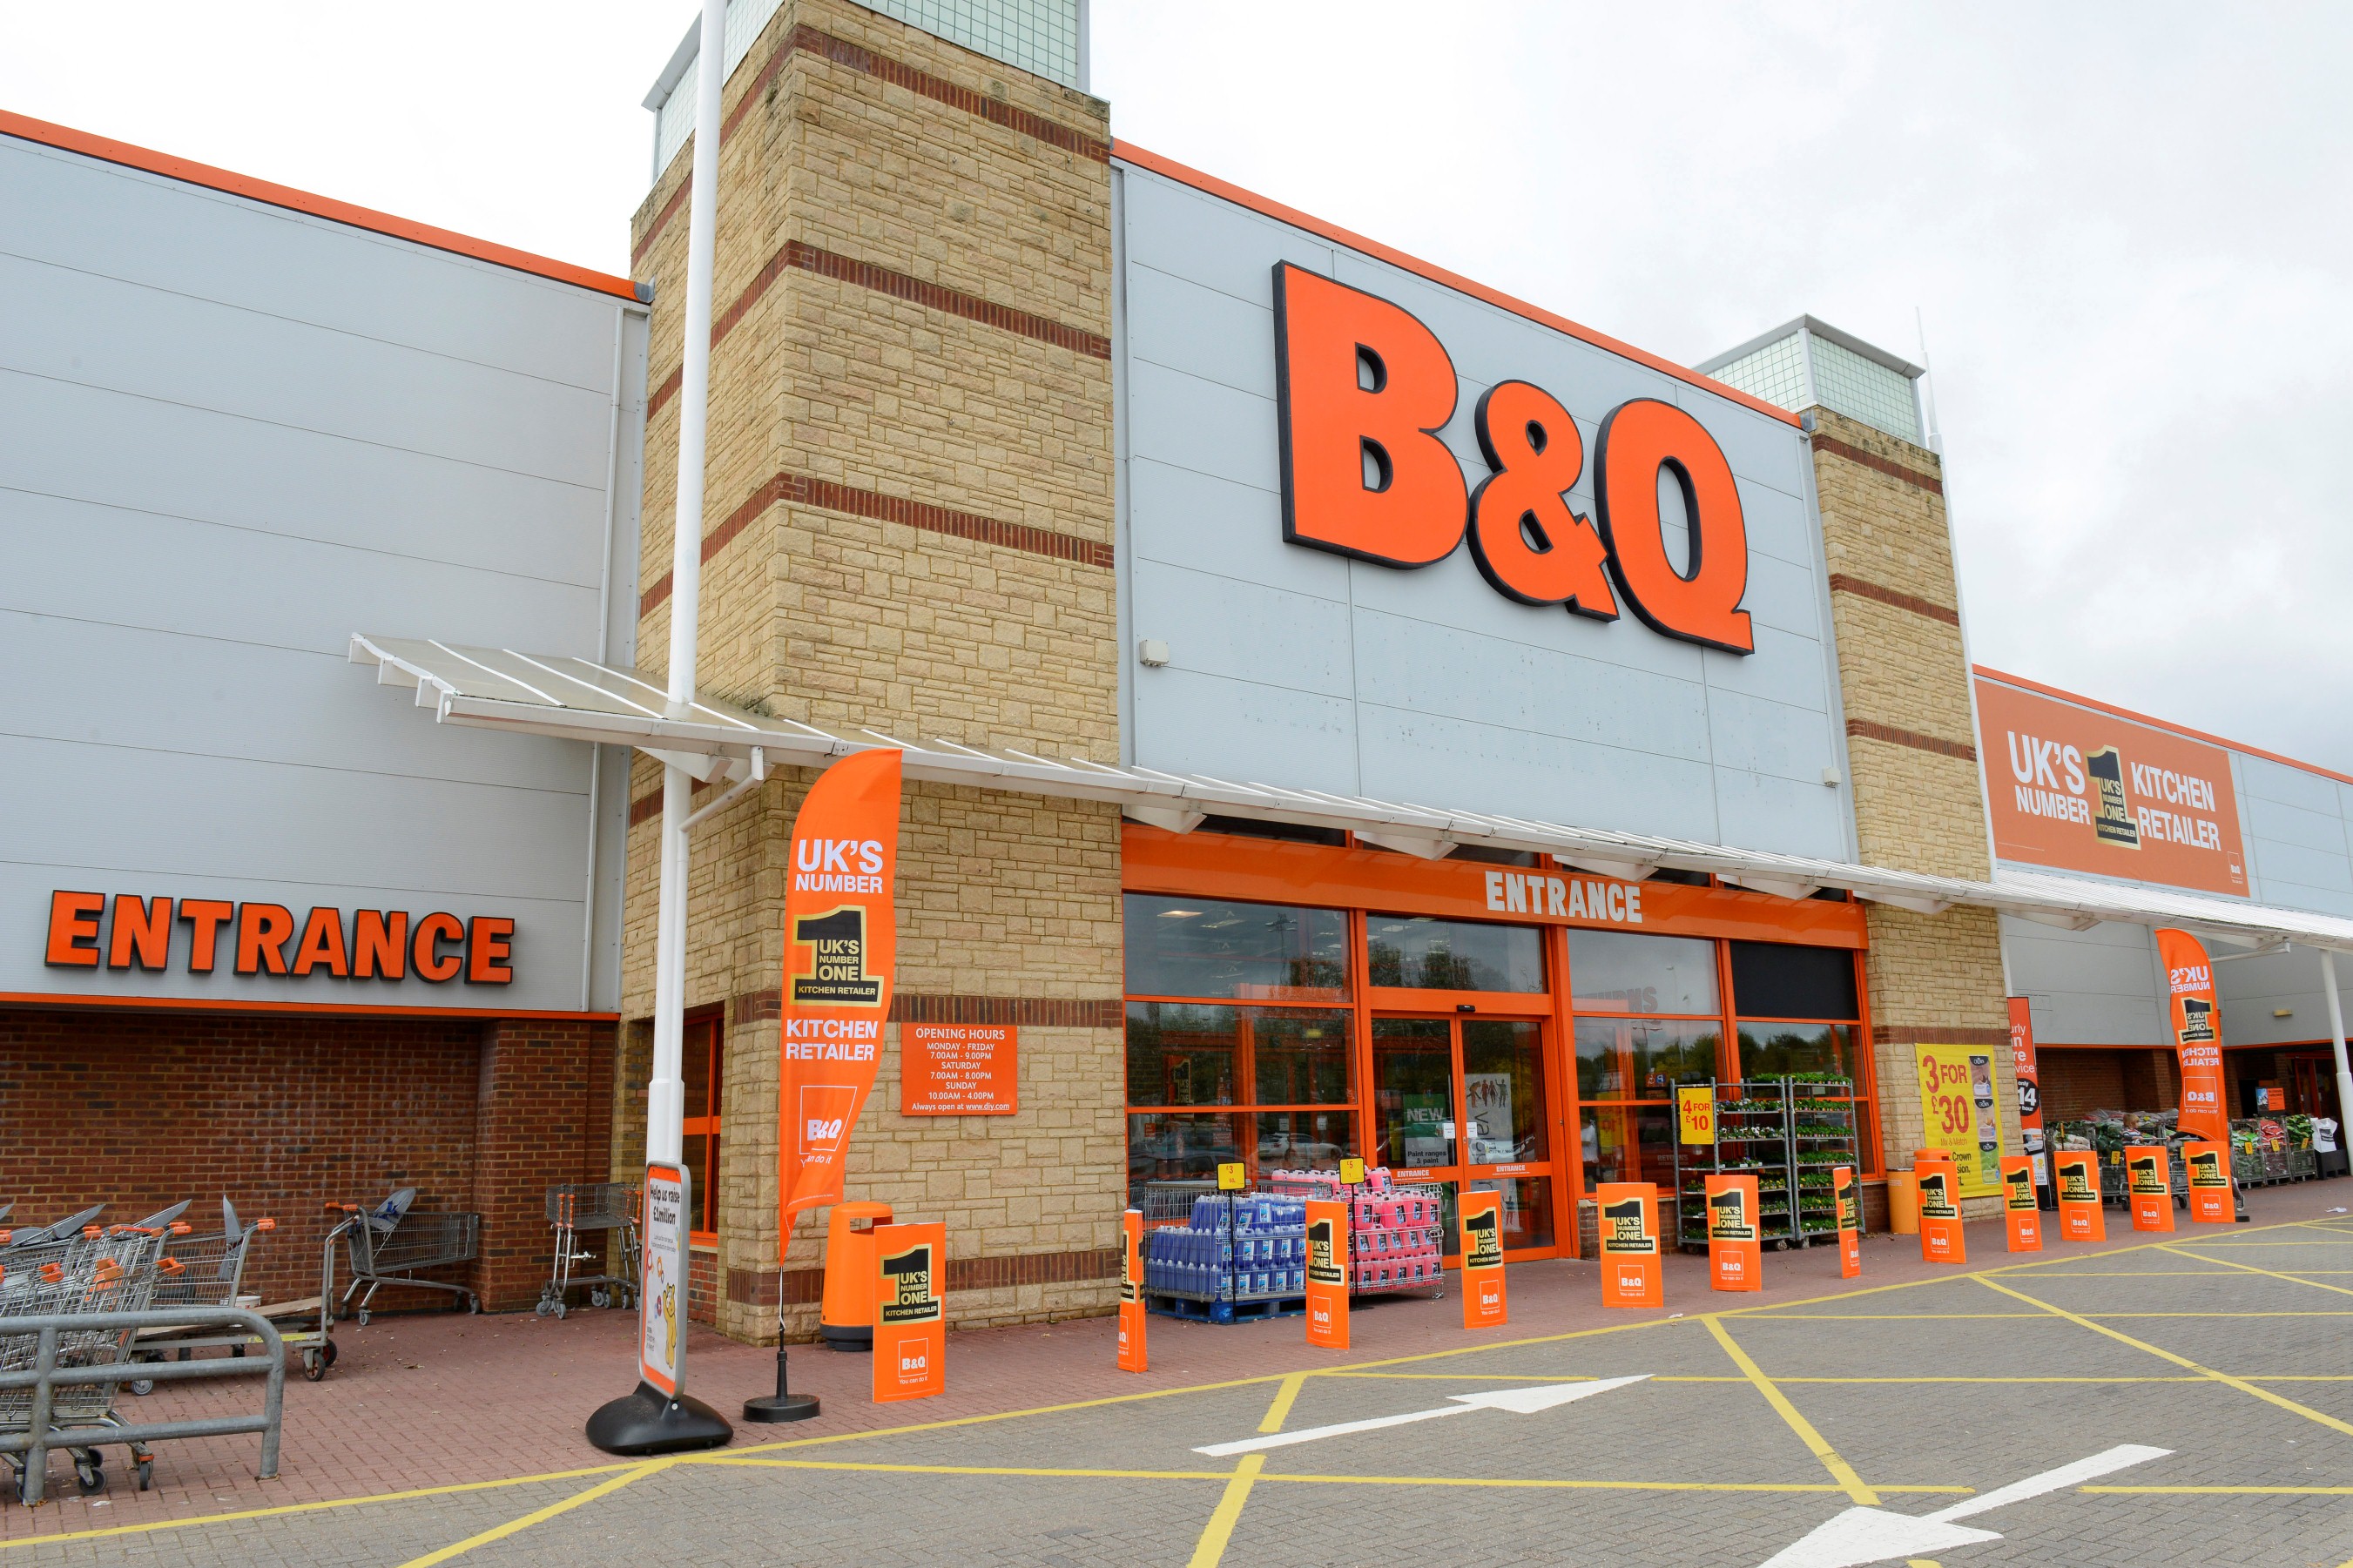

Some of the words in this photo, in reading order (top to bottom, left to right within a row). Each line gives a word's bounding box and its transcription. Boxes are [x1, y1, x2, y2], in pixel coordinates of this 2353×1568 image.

[1271, 259, 1755, 656] B&Q
[2007, 730, 2085, 794] UK'S
[2100, 777, 2121, 796] UK'S
[2130, 762, 2215, 811] KITCHEN
[2015, 784, 2091, 824] NUMBER
[2103, 794, 2123, 804] NUMBER
[2104, 804, 2125, 822] ONE
[2137, 806, 2222, 851] RETAILER
[798, 839, 883, 874] UK'S
[795, 873, 883, 893] NUMBER
[1486, 871, 1642, 923] ENTRANCE
[44, 890, 515, 985] ENTRANCE
[819, 939, 860, 955] UK'S
[789, 905, 885, 1008] 1
[819, 966, 859, 981] ONE
[786, 1020, 878, 1039] KITCHEN
[916, 1027, 966, 1039] OPENING
[969, 1029, 1005, 1040] HOURS
[785, 1043, 874, 1060] RETAILER
[1922, 1055, 1939, 1094] 3
[1940, 1064, 1968, 1084] FOR
[2014, 1063, 2034, 1073] vice
[2018, 1087, 2037, 1106] 14
[912, 1103, 936, 1112] Always
[966, 1102, 1010, 1111] www.diy.com
[1407, 1107, 1444, 1122] NEW
[1682, 1100, 1692, 1114] 4
[1932, 1094, 1970, 1134] £30
[807, 1119, 842, 1141] B&Q
[1686, 1115, 1709, 1130] £10
[1952, 1152, 1972, 1161] Crown
[1496, 1164, 1526, 1173] ENTRANCE
[1957, 1164, 1971, 1174] sion,
[650, 1184, 661, 1204] Help
[668, 1187, 680, 1203] raise
[1617, 1217, 1641, 1226] UK'S
[1721, 1220, 1741, 1228] ONE
[1479, 1228, 1495, 1238] UK'S
[1617, 1231, 1642, 1241] ONE
[1479, 1243, 1496, 1255] ONE
[1313, 1256, 1330, 1269] ONE
[1722, 1262, 1741, 1271] B&Q
[880, 1243, 941, 1326] 1
[900, 1271, 927, 1284] UK'S
[1621, 1277, 1642, 1287] B&Q
[900, 1283, 927, 1292] NUMBER
[900, 1291, 927, 1305] ONE
[1482, 1294, 1498, 1304] B&Q
[914, 1306, 937, 1315] RETAILER
[1314, 1310, 1329, 1322] B&Q
[902, 1356, 926, 1370] B&Q
